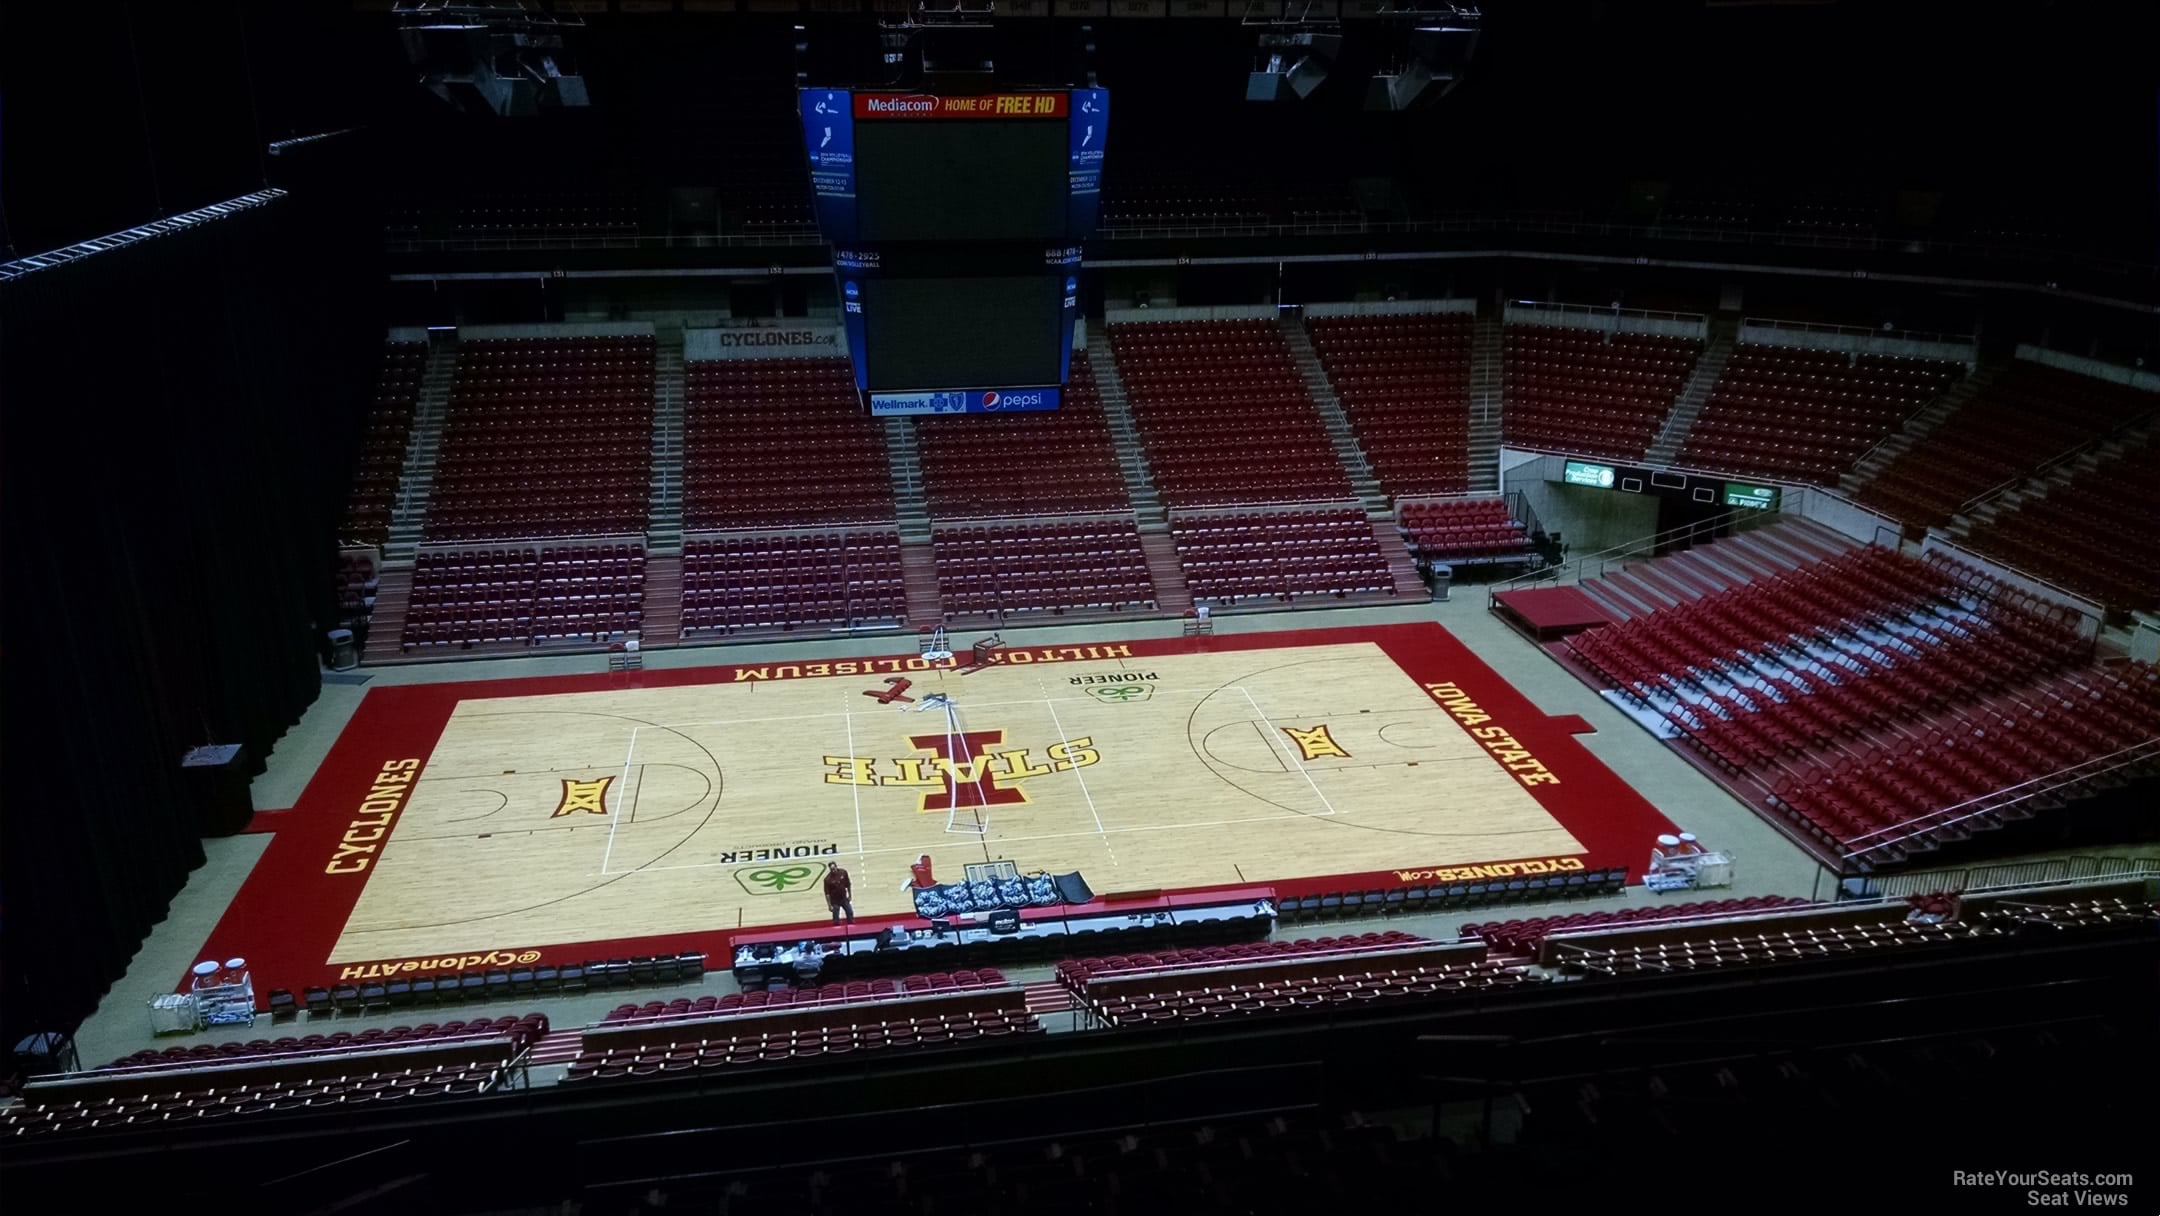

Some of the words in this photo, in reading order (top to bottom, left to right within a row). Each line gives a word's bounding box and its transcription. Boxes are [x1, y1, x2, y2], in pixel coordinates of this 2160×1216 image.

[868, 98, 934, 111] Mediacom
[945, 99, 977, 112] HOME
[979, 99, 994, 111] OF
[996, 96, 1032, 114] FREE
[1034, 96, 1056, 113] HD
[872, 398, 926, 410] Wellmark
[1003, 393, 1042, 408] pepsi
[734, 654, 958, 681] COLISEUM
[1069, 672, 1161, 685] PIONEER
[1424, 681, 1492, 726] IOWA
[1471, 726, 1561, 786] STATE
[823, 736, 1101, 786] STATE
[325, 758, 420, 874] CYCLONES
[720, 843, 838, 864] PIONEER
[1394, 858, 1585, 882] CYCLONES.com
[339, 950, 542, 980] @CycloneATH
